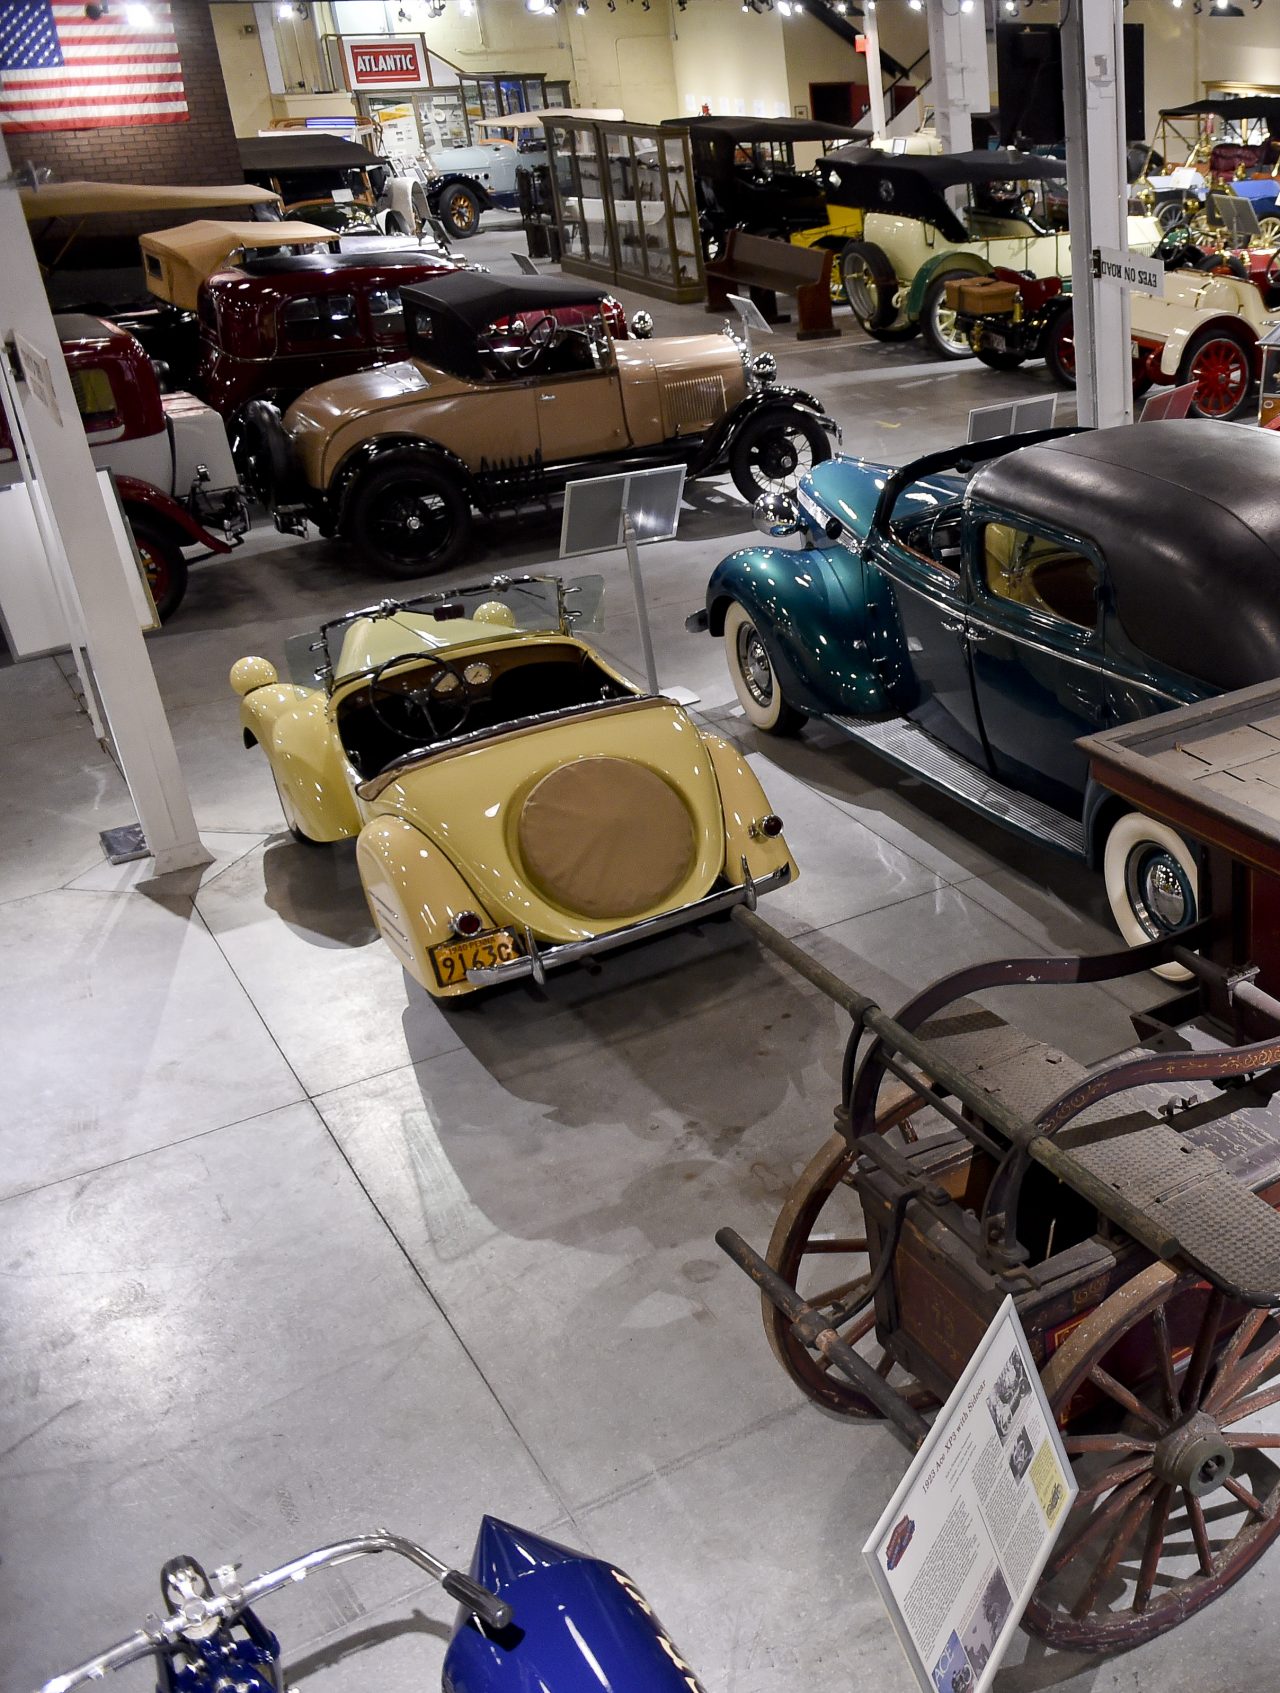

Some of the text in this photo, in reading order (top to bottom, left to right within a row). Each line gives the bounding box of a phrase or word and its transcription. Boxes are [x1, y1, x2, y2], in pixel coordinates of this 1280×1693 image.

[357, 54, 415, 72] ATLANTIC
[1101, 261, 1157, 288] EYES ON ROAD
[922, 1468, 936, 1495] 1923
[934, 1452, 946, 1471] Ace
[945, 1431, 957, 1455] XP3
[956, 1411, 969, 1433] with
[967, 1379, 986, 1412] Sidecar
[935, 1643, 955, 1688] ACE
